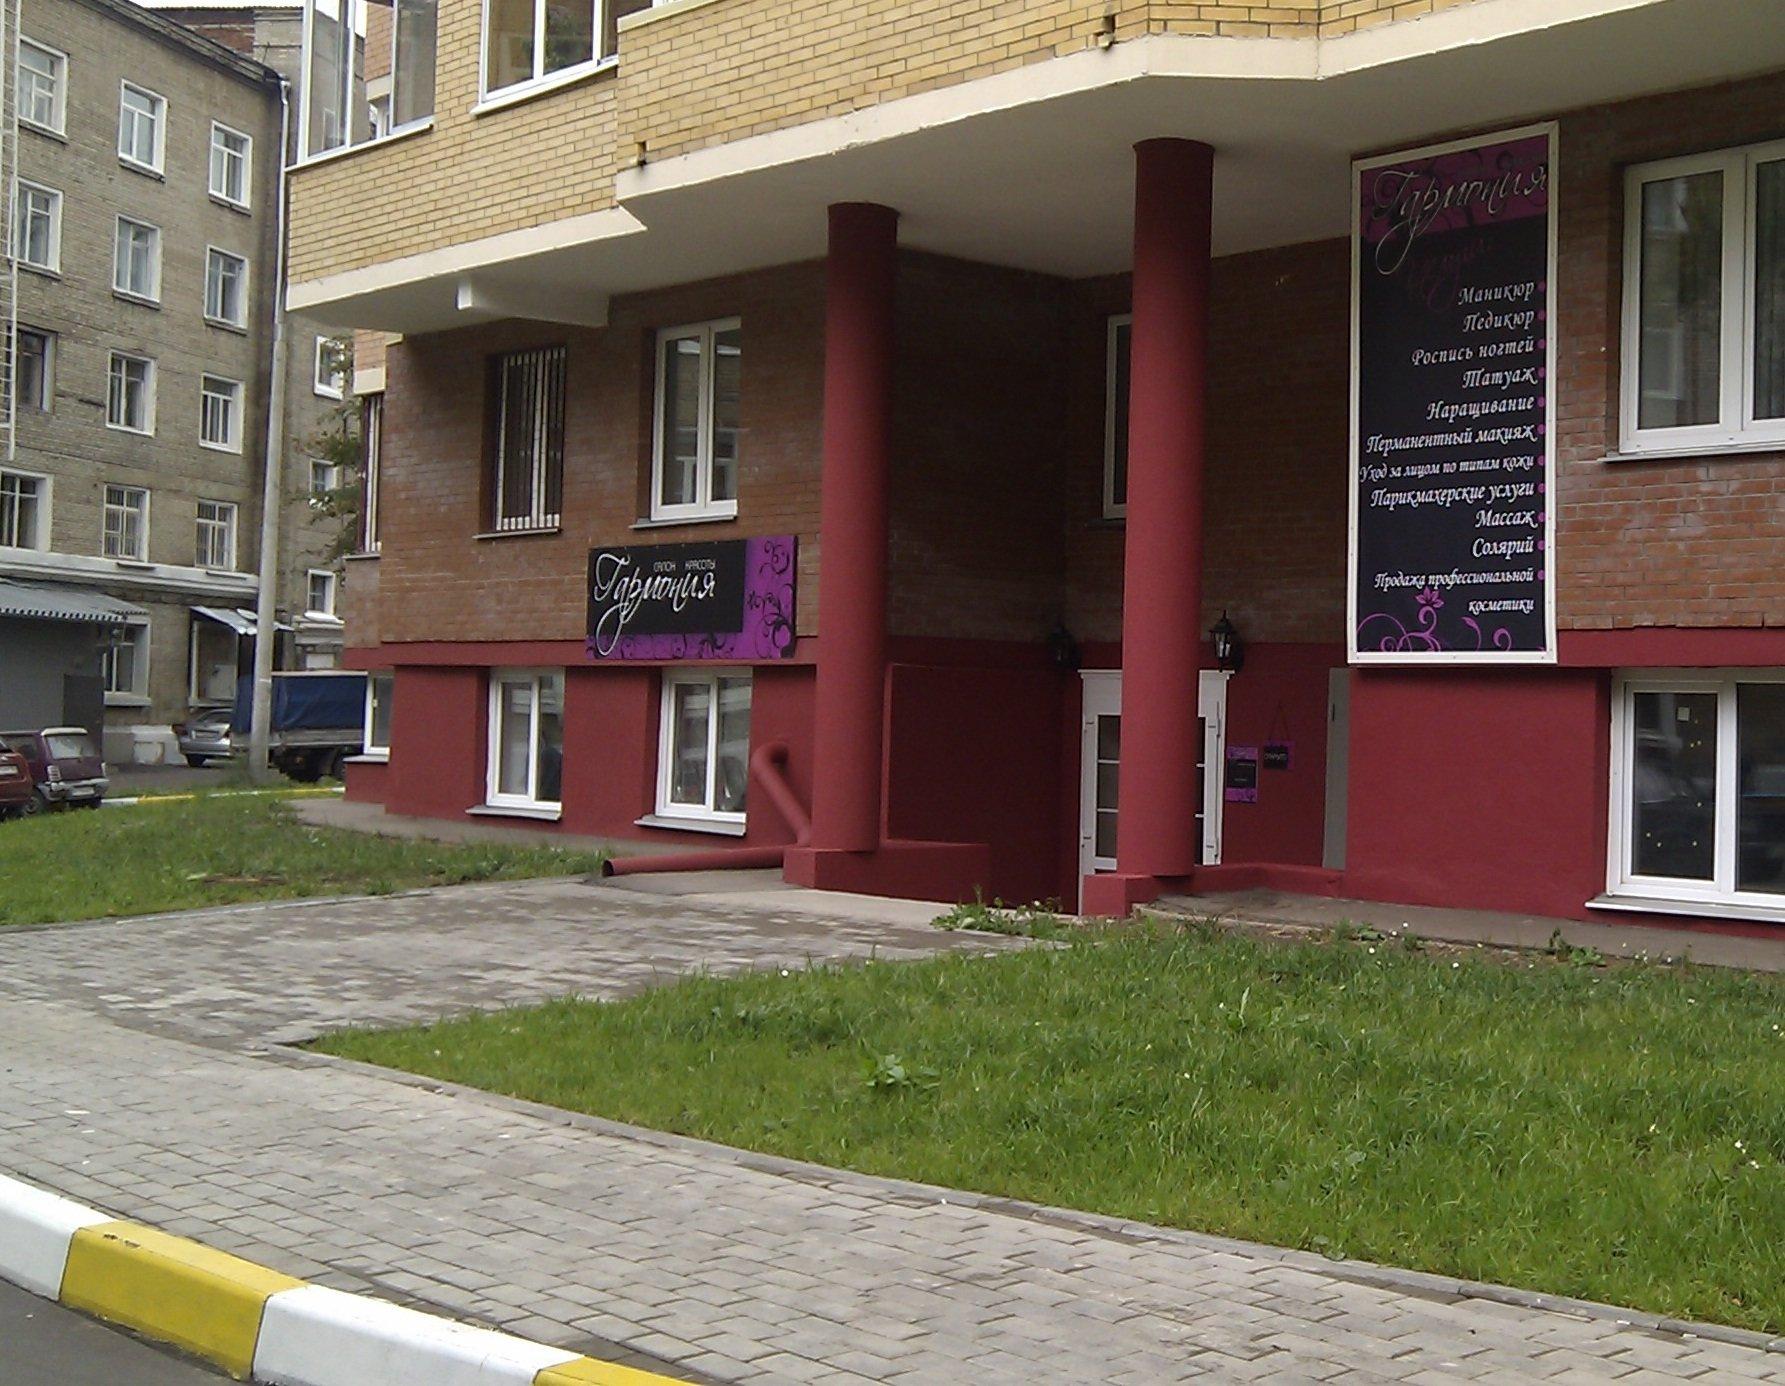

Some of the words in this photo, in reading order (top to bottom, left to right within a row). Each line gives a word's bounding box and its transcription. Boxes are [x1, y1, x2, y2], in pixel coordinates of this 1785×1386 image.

[1372, 165, 1548, 275] Гармония
[1458, 281, 1535, 306] Маникюр
[1463, 310, 1535, 332] Педикюр
[1411, 348, 1474, 367] Роспись
[1479, 336, 1534, 358] ногтей
[1462, 367, 1538, 388] Татуаж
[1426, 396, 1534, 423] Наращивание
[1366, 428, 1473, 456] Перманентный
[1474, 424, 1538, 444] макияж
[1360, 463, 1388, 483] Уход
[1389, 466, 1401, 478] за
[1404, 463, 1440, 478] лицом
[1443, 462, 1457, 475] по
[1459, 458, 1500, 471] типам
[1503, 455, 1534, 471] кожи
[1370, 487, 1485, 510] Парикмахерские
[1486, 483, 1534, 503] услуги
[1474, 510, 1538, 528] Массаж
[1472, 536, 1534, 560] Солярий
[1374, 572, 1426, 590] Продажа
[1428, 567, 1534, 589] профессиональной
[593, 553, 716, 655] Гармония
[1468, 598, 1534, 615] косметики
